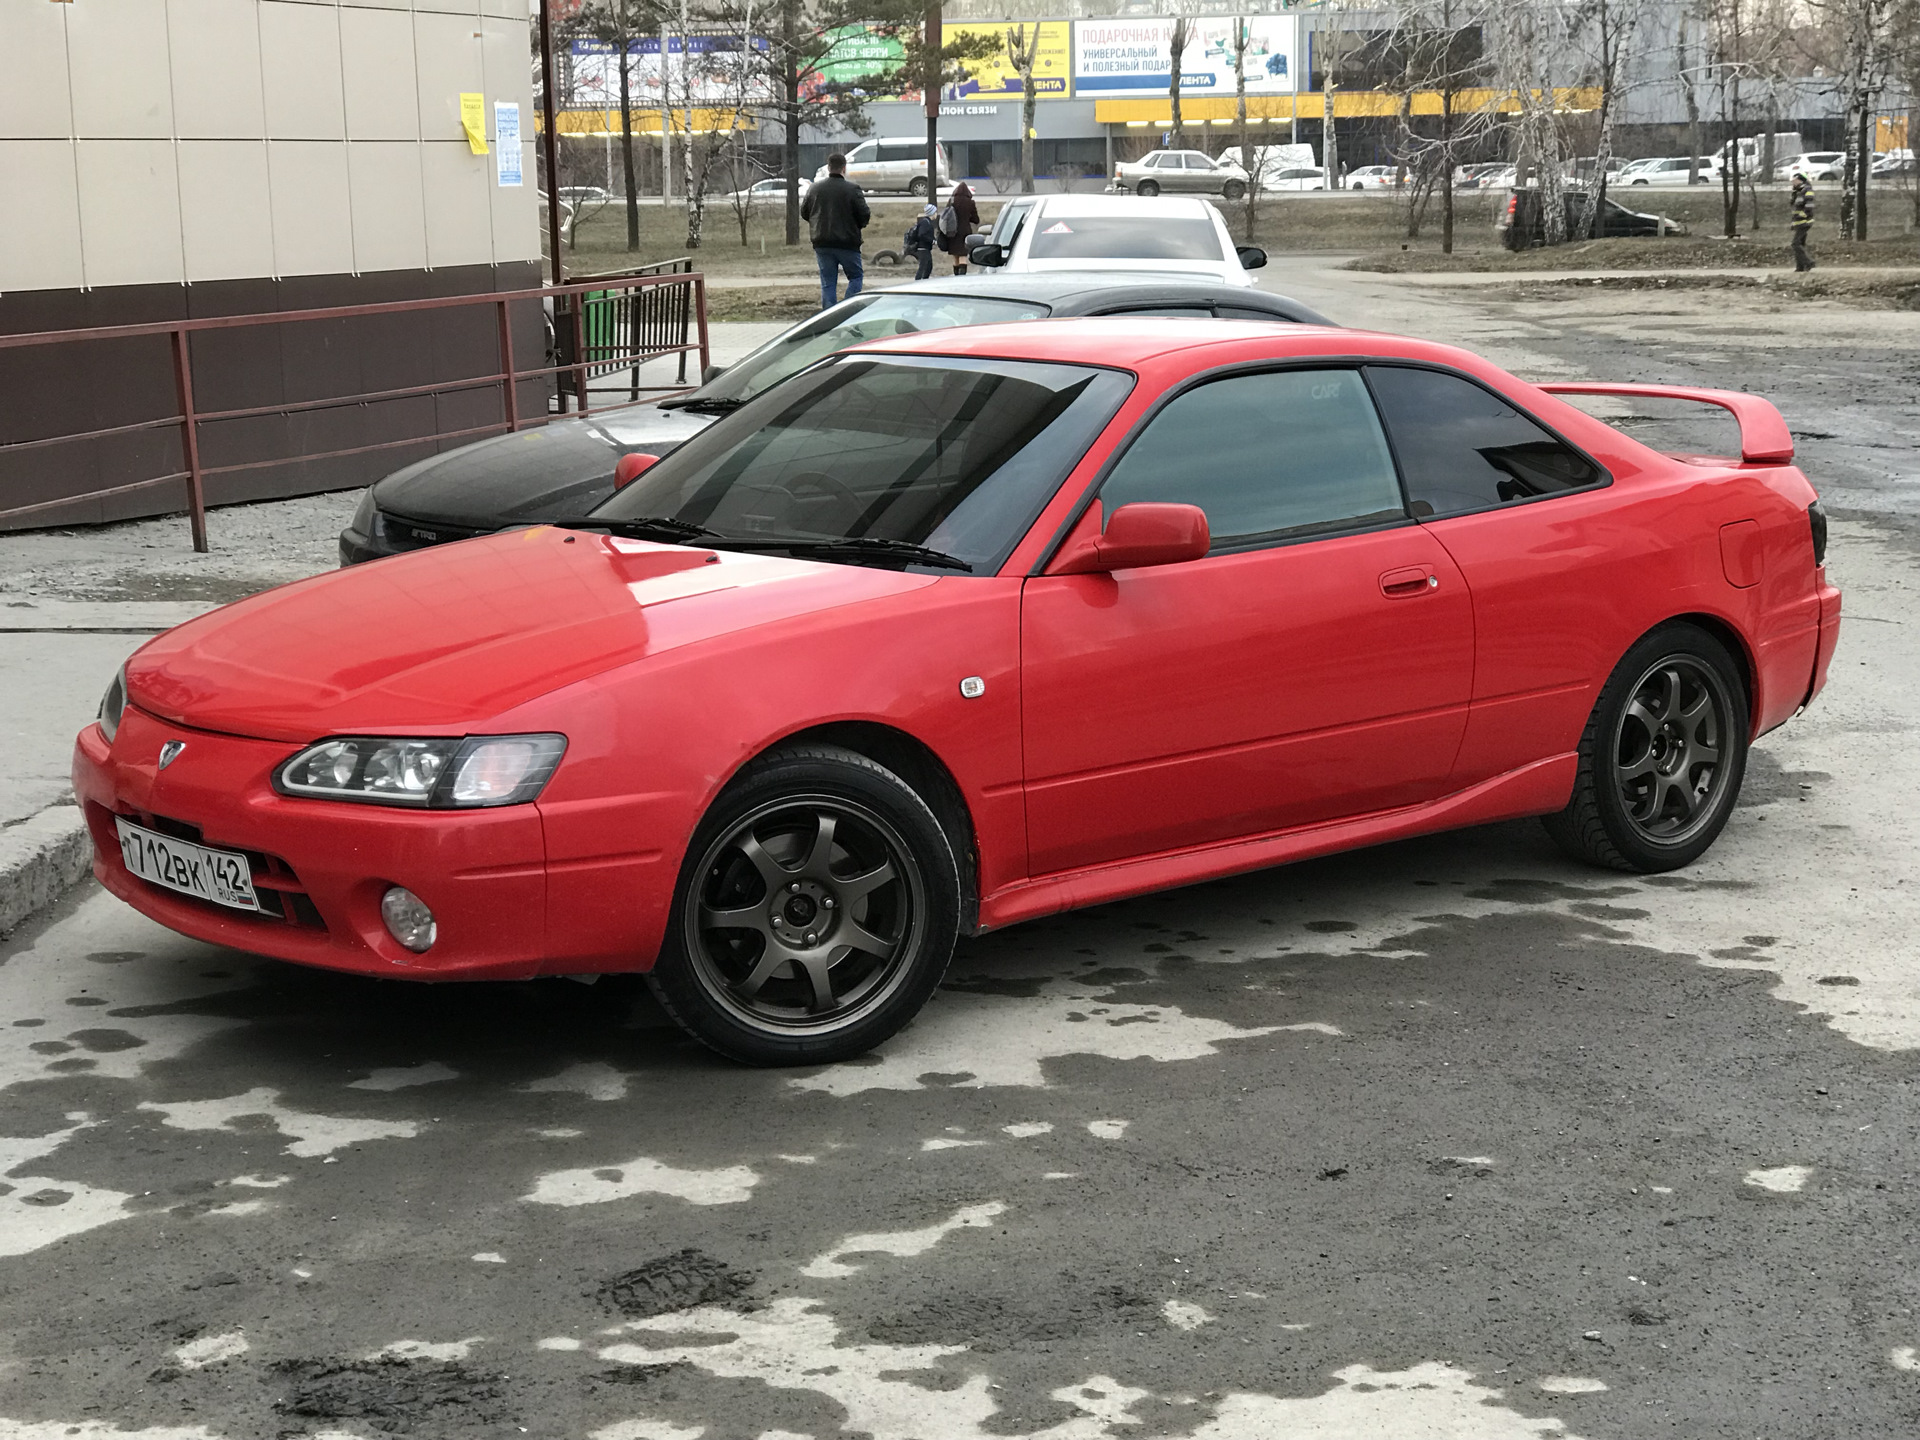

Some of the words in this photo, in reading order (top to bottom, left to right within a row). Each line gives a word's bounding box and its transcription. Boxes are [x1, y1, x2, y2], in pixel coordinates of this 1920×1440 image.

[1082, 28, 1159, 45] ПОДАРОЧНАЯ
[1083, 45, 1157, 59] УНИВЕРСАЛЬНЫЙ
[1083, 62, 1090, 72] И
[1092, 59, 1140, 72] ПОЛЕЗНЫЙ
[1142, 60, 1171, 72] ПОДАР
[1179, 75, 1212, 85] ЛЕНТА
[966, 106, 997, 115] СВЯЗИ
[206, 854, 244, 892] 142
[217, 887, 238, 902] RUS
